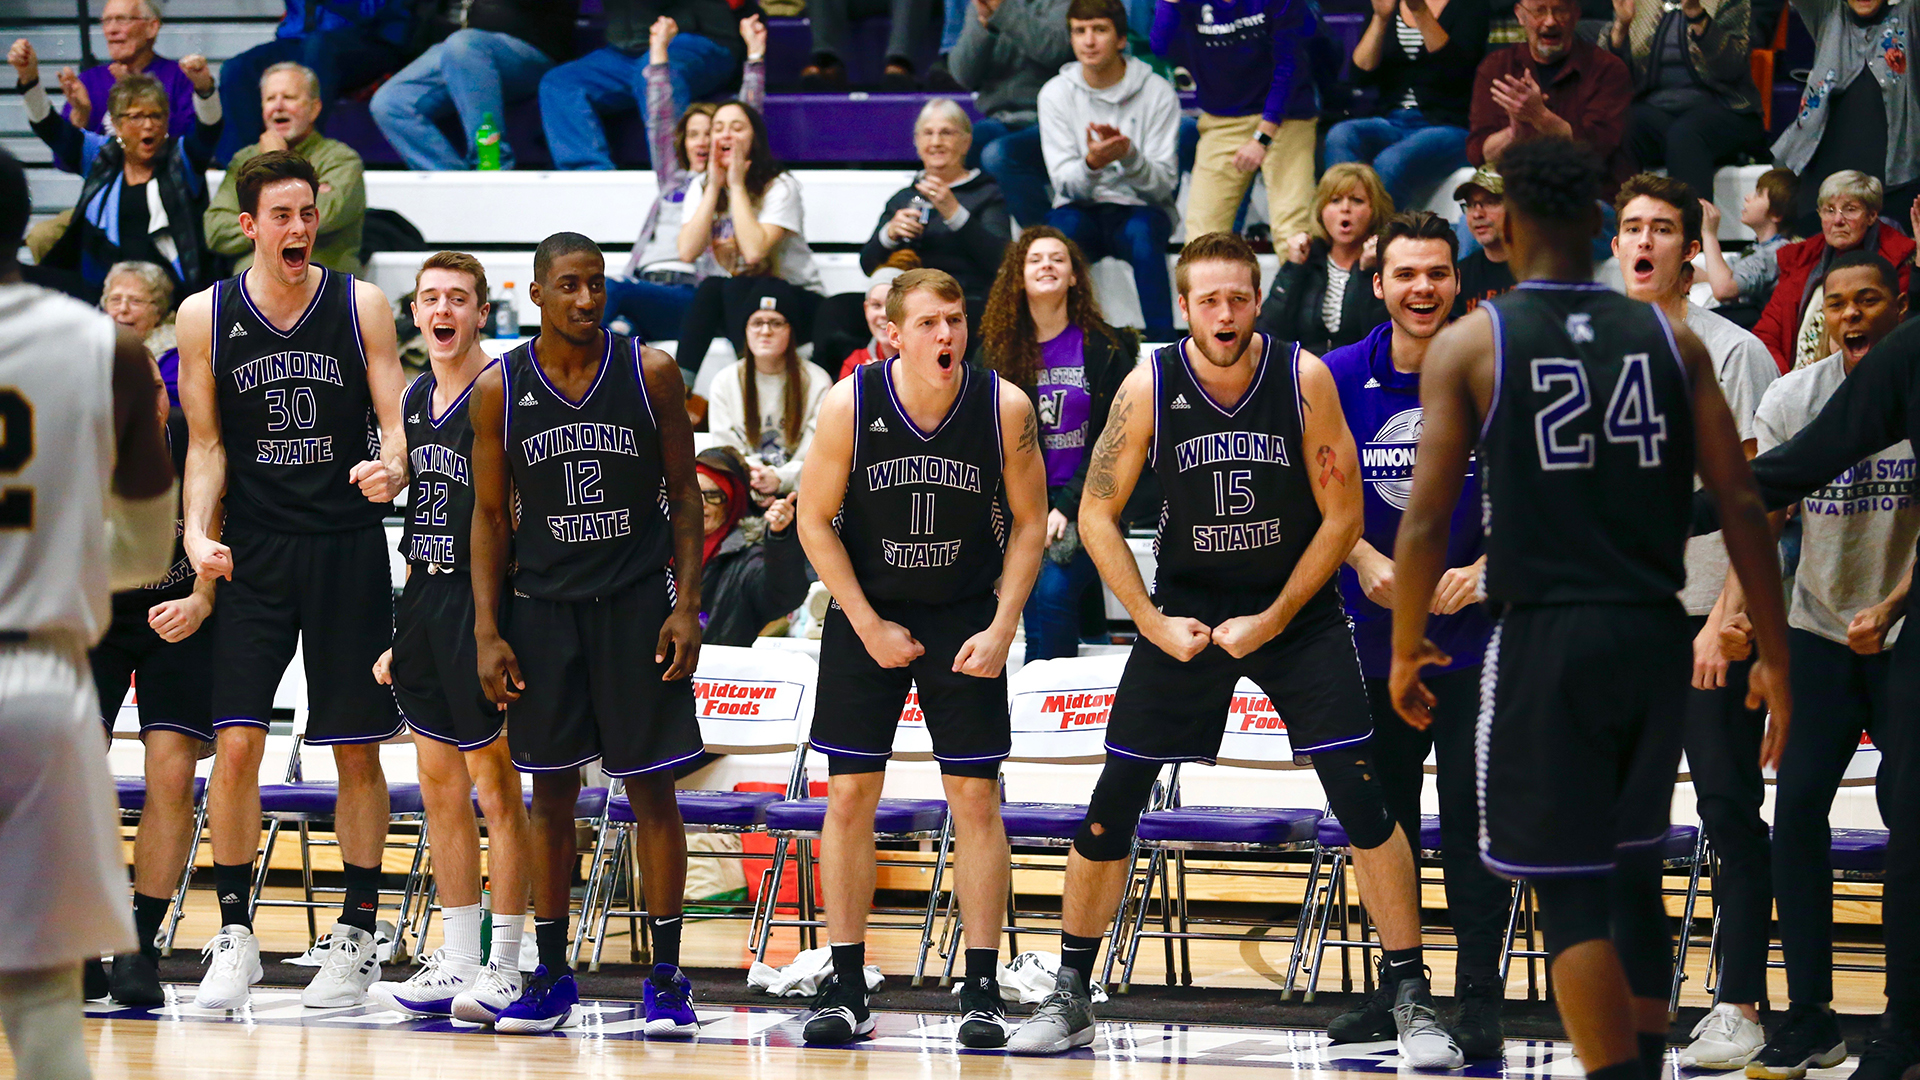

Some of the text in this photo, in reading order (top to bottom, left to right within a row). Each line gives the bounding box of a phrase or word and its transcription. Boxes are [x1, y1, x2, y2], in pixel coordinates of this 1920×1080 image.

[232, 351, 343, 393] WINONA
[265, 387, 317, 431] 30
[518, 399, 539, 407] adidas
[1170, 402, 1191, 410] adidas
[1530, 353, 1667, 471] 24
[256, 436, 333, 465] STATE
[522, 422, 639, 466] WINONA
[1175, 431, 1290, 473] WINONA
[1362, 448, 1417, 467] WINON
[563, 460, 603, 506] 12
[866, 455, 981, 493] WINONA
[1876, 458, 1916, 479] STAT
[414, 481, 448, 526] 22
[1213, 470, 1255, 516] 15
[1811, 484, 1909, 497] BASKETBAL
[910, 493, 935, 535] 11
[1806, 497, 1911, 516] WARRIOR
[547, 508, 631, 543] STATE
[1193, 518, 1281, 551] STATE
[882, 539, 961, 568] STATE
[693, 682, 777, 699] Midtown
[1041, 693, 1115, 713] Midtow
[702, 700, 760, 716] Foods
[1060, 709, 1111, 729] Food
[1230, 697, 1277, 714] Midt
[1240, 714, 1288, 731] Food
